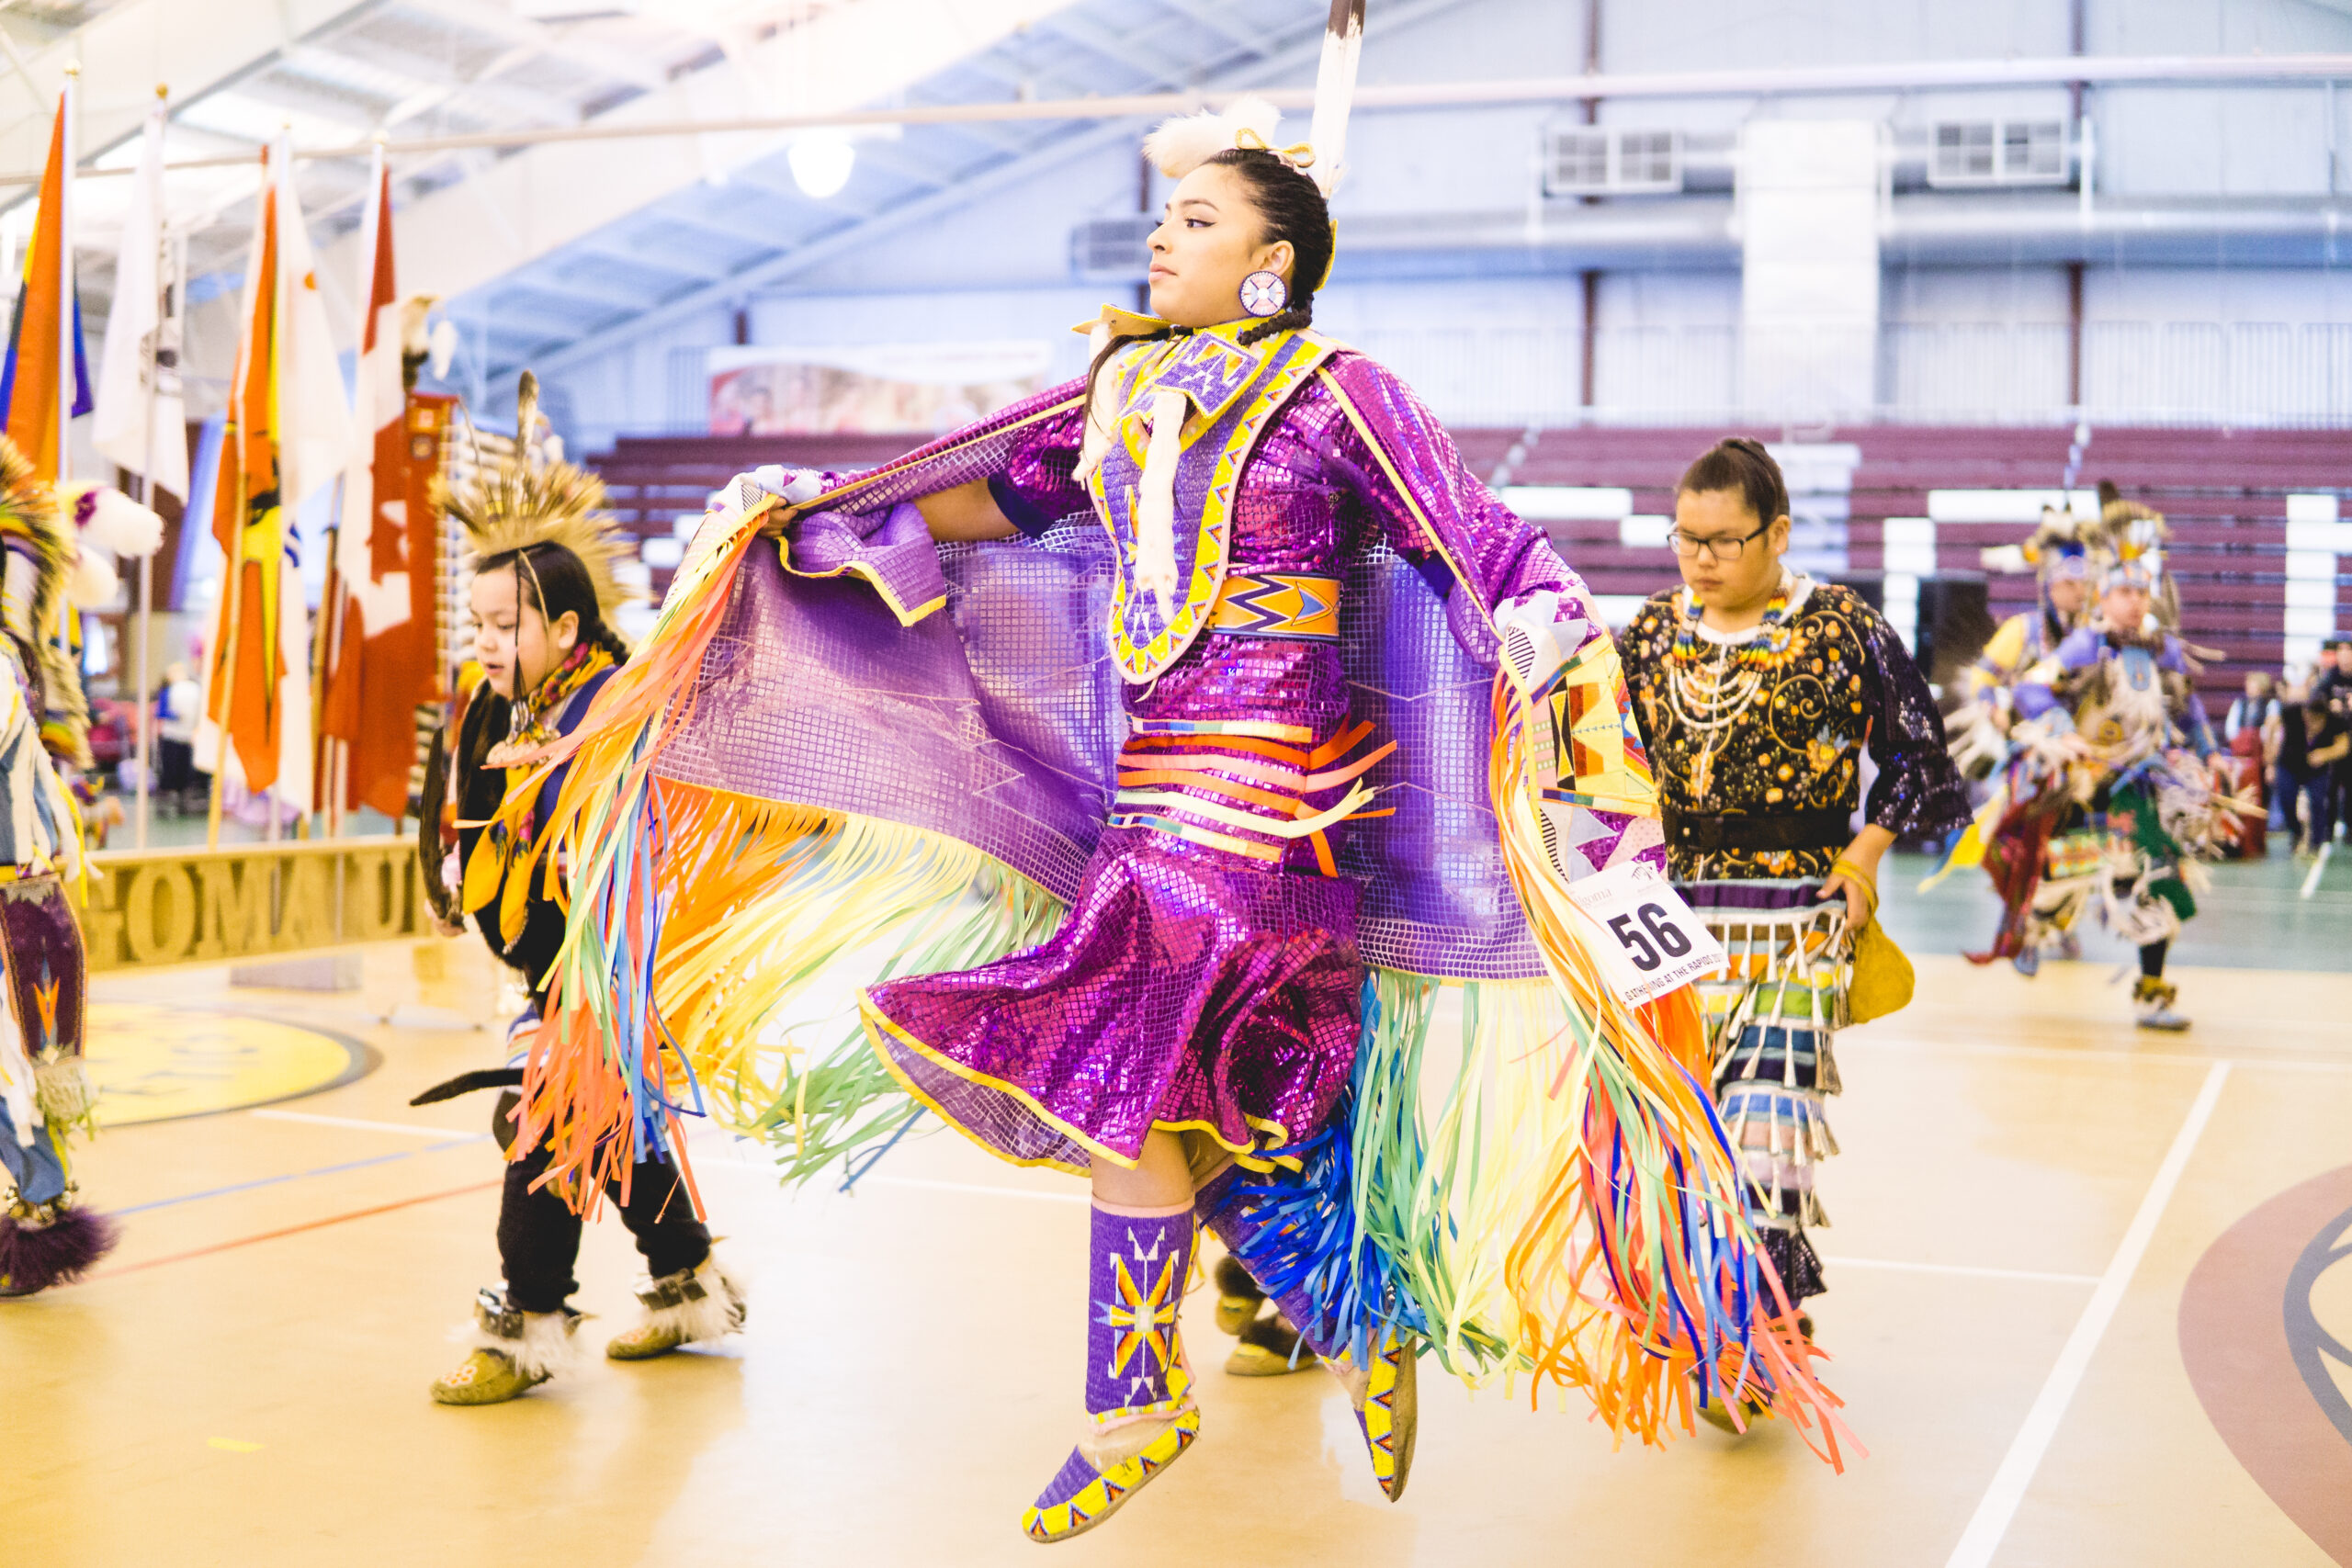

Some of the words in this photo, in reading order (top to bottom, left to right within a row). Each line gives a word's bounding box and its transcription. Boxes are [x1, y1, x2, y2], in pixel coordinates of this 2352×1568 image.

[1606, 902, 1692, 972] 56
[1663, 972, 1675, 985] AT
[1671, 965, 1690, 980] THE
[1687, 954, 1713, 972] RAPIDS
